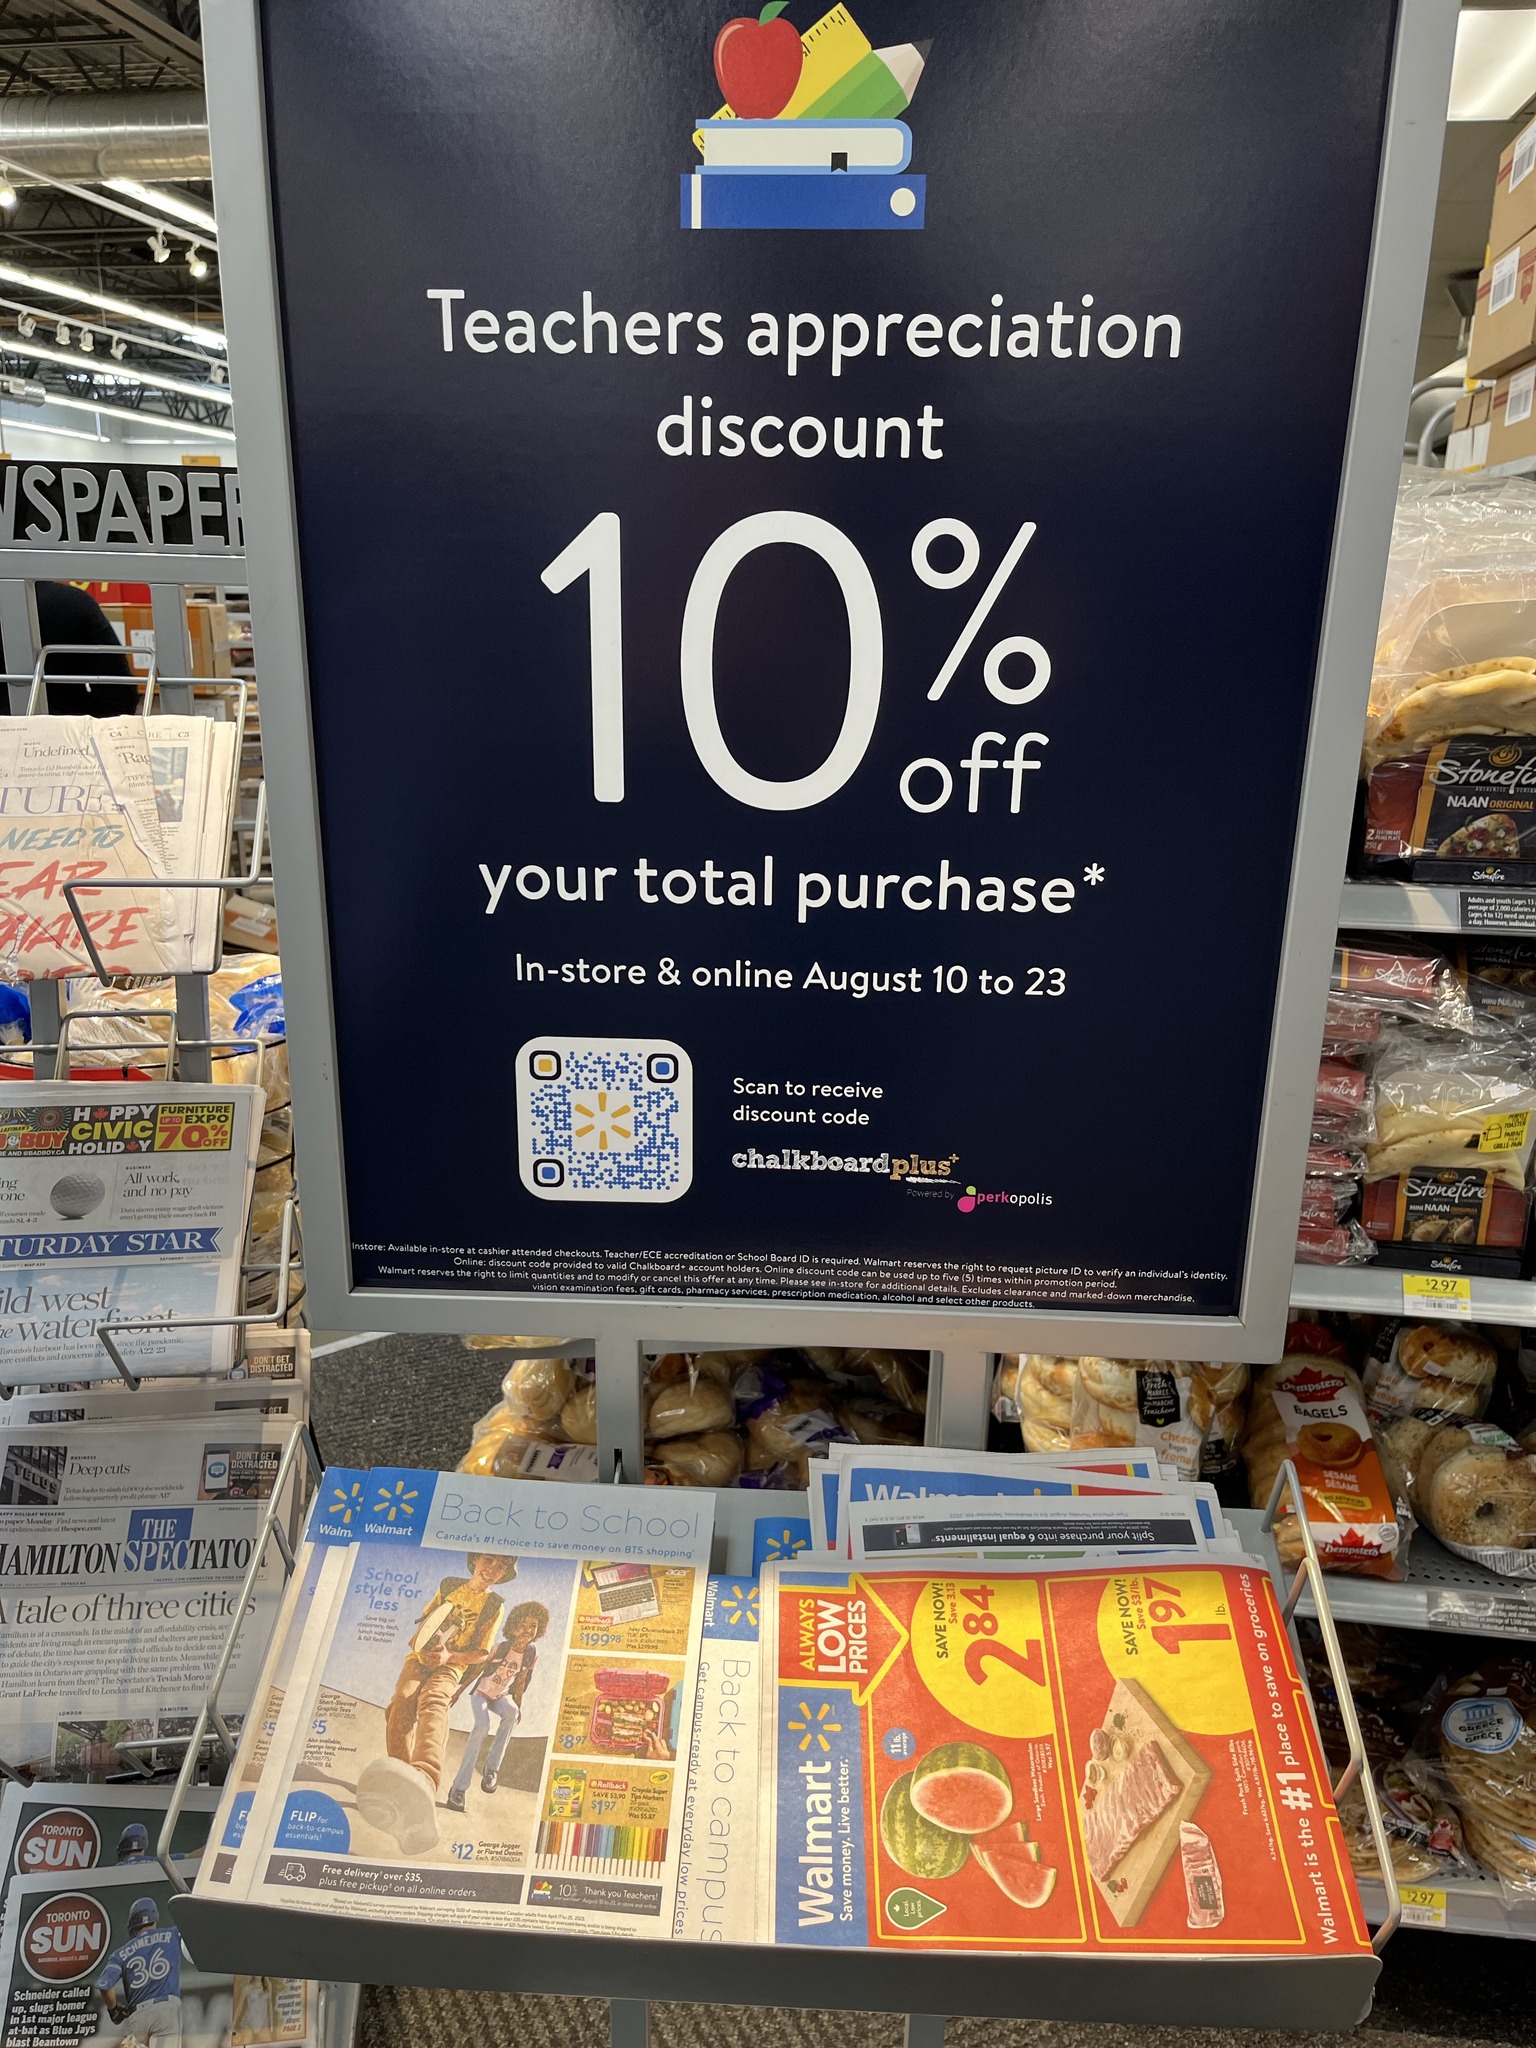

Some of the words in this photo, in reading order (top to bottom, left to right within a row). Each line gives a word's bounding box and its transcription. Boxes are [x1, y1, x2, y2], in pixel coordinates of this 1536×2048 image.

[426, 289, 724, 357] Teachers
[747, 294, 1183, 376] appreciation
[656, 396, 944, 459] discount
[540, 510, 1052, 812] 10%
[23, 744, 90, 758] Undefined
[900, 731, 1050, 815] off
[1446, 795, 1489, 808] NAAN
[1489, 800, 1534, 810] ORIGINAL
[90, 824, 125, 849] TO
[478, 862, 617, 915] your
[634, 855, 774, 906] total
[1471, 868, 1506, 882] Stonefire
[514, 953, 647, 985] In-store
[657, 957, 682, 988] &
[691, 959, 794, 990] online
[802, 962, 923, 999] August
[932, 965, 969, 994] 10
[978, 969, 1015, 996] to
[1025, 967, 1067, 997] 23
[732, 1077, 780, 1096] Scan
[784, 1080, 807, 1097] to
[811, 1082, 884, 1099] receive
[160, 1103, 231, 1116] FURNITURE
[184, 1113, 229, 1125] EXPO
[732, 1105, 817, 1124] discount
[821, 1108, 870, 1126] code
[19, 1130, 68, 1151] BOY
[71, 1120, 154, 1142] CIVIC
[158, 1124, 229, 1150] 70%
[202, 1138, 228, 1149] OFF
[124, 1172, 144, 1186] All
[145, 1172, 181, 1186] work,
[1402, 1175, 1489, 1204] Stonefire
[122, 1185, 147, 1199] and
[150, 1187, 168, 1197] no
[170, 1187, 194, 1200] pay
[906, 1188, 944, 1200] Powered
[944, 1190, 956, 1201] by
[976, 1191, 1054, 1207] perkopolis
[1424, 1203, 1450, 1213] NAAN
[126, 1231, 206, 1253] STAR
[1430, 1259, 1462, 1272] Stonefire
[41, 1286, 114, 1312] west
[532, 1283, 558, 1292] vision
[559, 1284, 614, 1293] examination
[616, 1285, 639, 1295] fees,
[639, 1286, 656, 1297] gift
[657, 1287, 685, 1297] cards,
[686, 1287, 729, 1299] pharmacy
[731, 1289, 770, 1299] services,
[771, 1290, 826, 1301] prescription
[827, 1291, 880, 1302] medication,
[882, 1293, 915, 1303] alcohol
[916, 1294, 934, 1304] and
[935, 1295, 963, 1306] select
[964, 1297, 991, 1307] other
[992, 1298, 1035, 1310] products.
[1294, 1405, 1348, 1419] BAGELS
[1160, 1431, 1199, 1446] Cheese
[231, 1460, 278, 1470] DISTRACTED
[236, 1451, 259, 1462] DON'T
[260, 1451, 276, 1461] GET
[69, 1461, 104, 1479] Deep
[106, 1463, 131, 1476] cuts
[440, 1492, 521, 1529] Back
[534, 1505, 569, 1532] to
[581, 1504, 699, 1540] School
[141, 1518, 177, 1539] THE
[364, 1523, 413, 1536] Walmart
[364, 1567, 420, 1584] School
[354, 1583, 394, 1599] style
[397, 1584, 423, 1599] for
[1113, 1578, 1133, 1620] NOW!
[15, 1595, 67, 1626] tale
[71, 1592, 107, 1624] of
[106, 1591, 180, 1622] three
[369, 1596, 399, 1612] less
[703, 1581, 719, 1628] Walmart
[932, 1581, 947, 1623] NOW!
[1235, 1572, 1269, 1640] groceries
[799, 1598, 816, 1671] ALWAYS
[817, 1599, 848, 1673] LOW
[849, 1599, 869, 1675] PRICES
[935, 1624, 949, 1661] SAVE
[1124, 1620, 1139, 1656] SAVE
[1258, 1641, 1271, 1661] on
[1261, 1663, 1280, 1698] save
[718, 1658, 751, 1738] Back
[1271, 1699, 1283, 1719] to
[1459, 1717, 1505, 1733] GREECE
[1276, 1720, 1301, 1767] place
[1464, 1731, 1504, 1744] GRECE
[713, 1750, 741, 1784] to
[597, 1780, 627, 1790] Rollback
[1275, 1771, 1314, 1812] #1
[290, 1809, 317, 1822] FLIP
[317, 1815, 329, 1825] for
[42, 1824, 84, 1837] TORONTO
[285, 1831, 323, 1842] essentials!
[287, 1823, 345, 1836] back-to-campus
[1297, 1817, 1314, 1848] the
[24, 1836, 93, 1869] SUN
[450, 1841, 474, 1861] $12
[798, 1758, 834, 1928] Walmart
[1304, 1852, 1318, 1870] is
[584, 1886, 607, 1898] Thank
[607, 1888, 623, 1901] you
[622, 1889, 659, 1902] Teachers!
[46, 1909, 91, 1924] TORONTO
[1316, 1870, 1339, 1945] Walmart
[30, 1922, 102, 1955] SUN
[118, 1931, 173, 1962] SCHNEIDER
[125, 1947, 171, 1990] 36
[13, 1989, 61, 2002] Schneider
[62, 1986, 91, 2000] called
[29, 2002, 55, 2014] slugs
[56, 2000, 87, 2012] homer
[10, 2015, 20, 2025] in
[21, 2014, 37, 2025] 1st
[37, 2013, 66, 2026] major
[66, 2012, 98, 2024] league
[8, 2025, 38, 2035] at-bat
[39, 2026, 51, 2035] as
[52, 2024, 74, 2035] Blue
[74, 2024, 96, 2036] Jays
[6, 2037, 31, 2048] blast
[31, 2036, 79, 2048] Beantown
